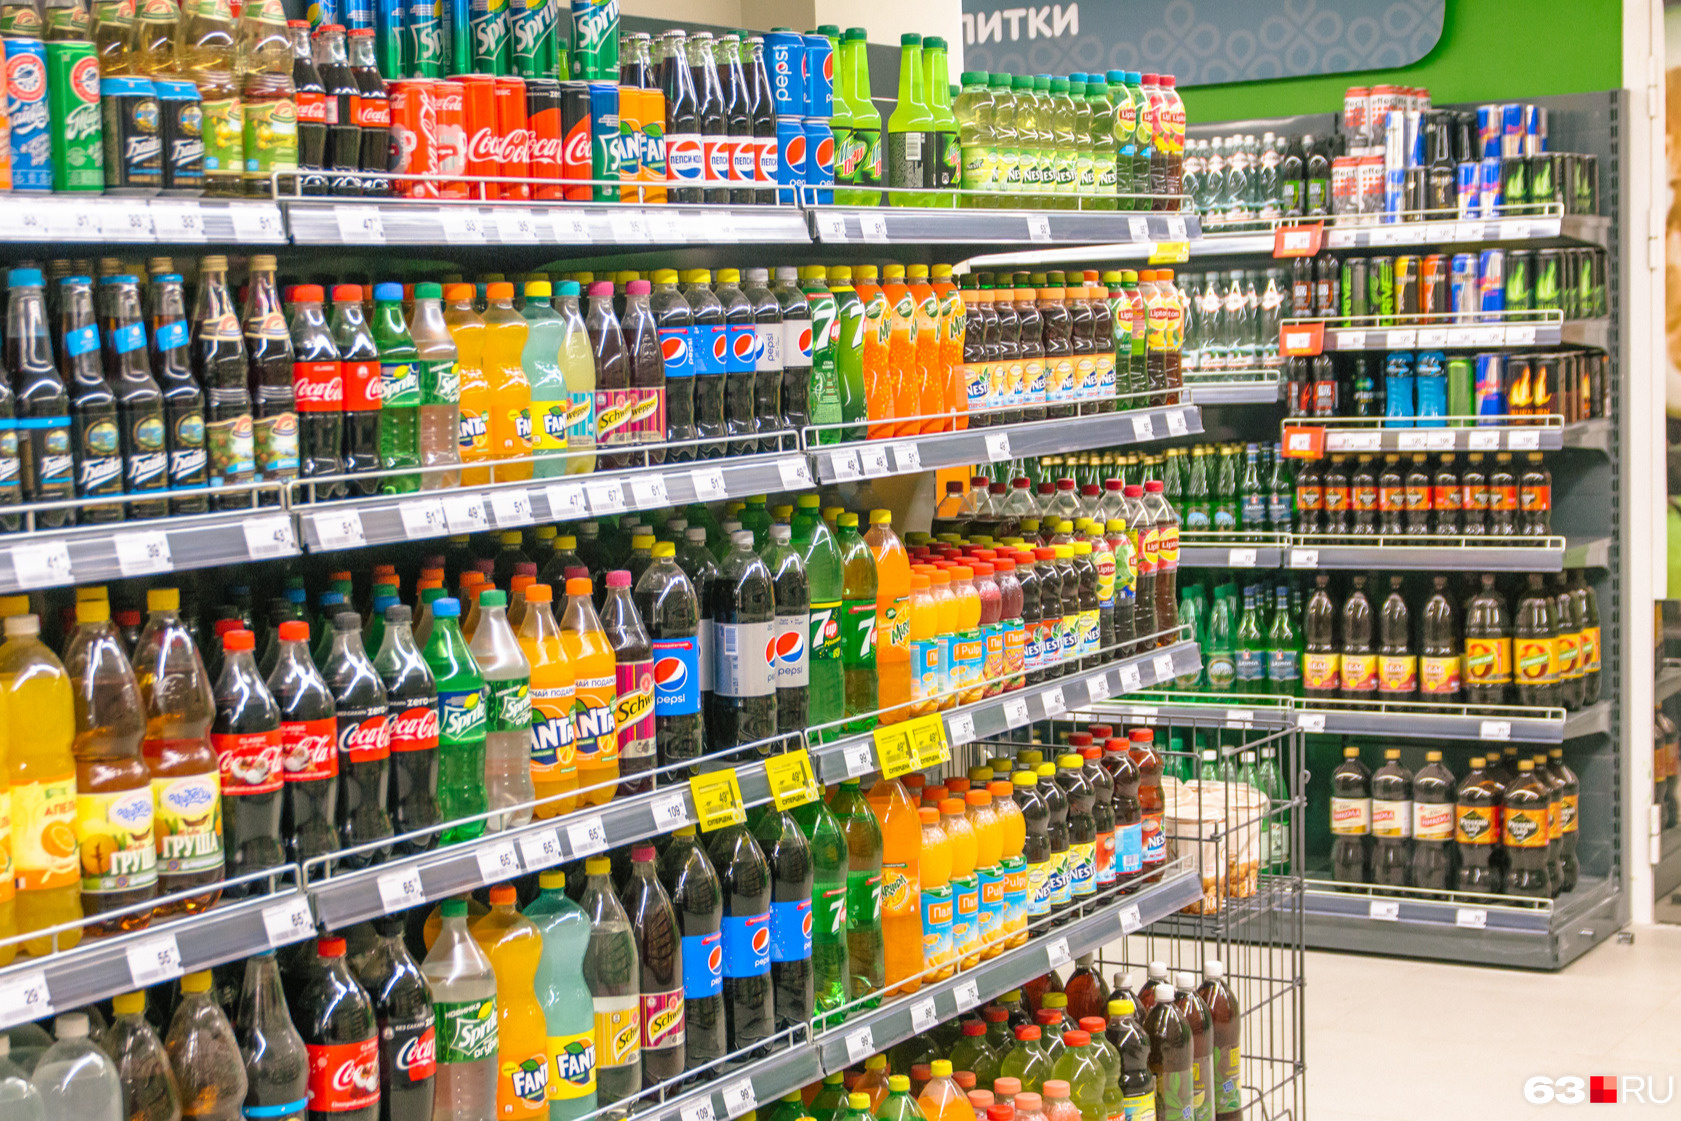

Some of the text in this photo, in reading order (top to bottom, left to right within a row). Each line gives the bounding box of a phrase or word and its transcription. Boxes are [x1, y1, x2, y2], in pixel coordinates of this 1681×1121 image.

[778, 664, 804, 682] pepsi
[657, 694, 686, 707] pepsi
[889, 760, 911, 776] СУПЕРЦЕНА
[782, 793, 807, 807] СУПЕРЦЕНА
[707, 815, 734, 829] СУПЕРЦЕНА
[162, 833, 219, 860] ГРУША
